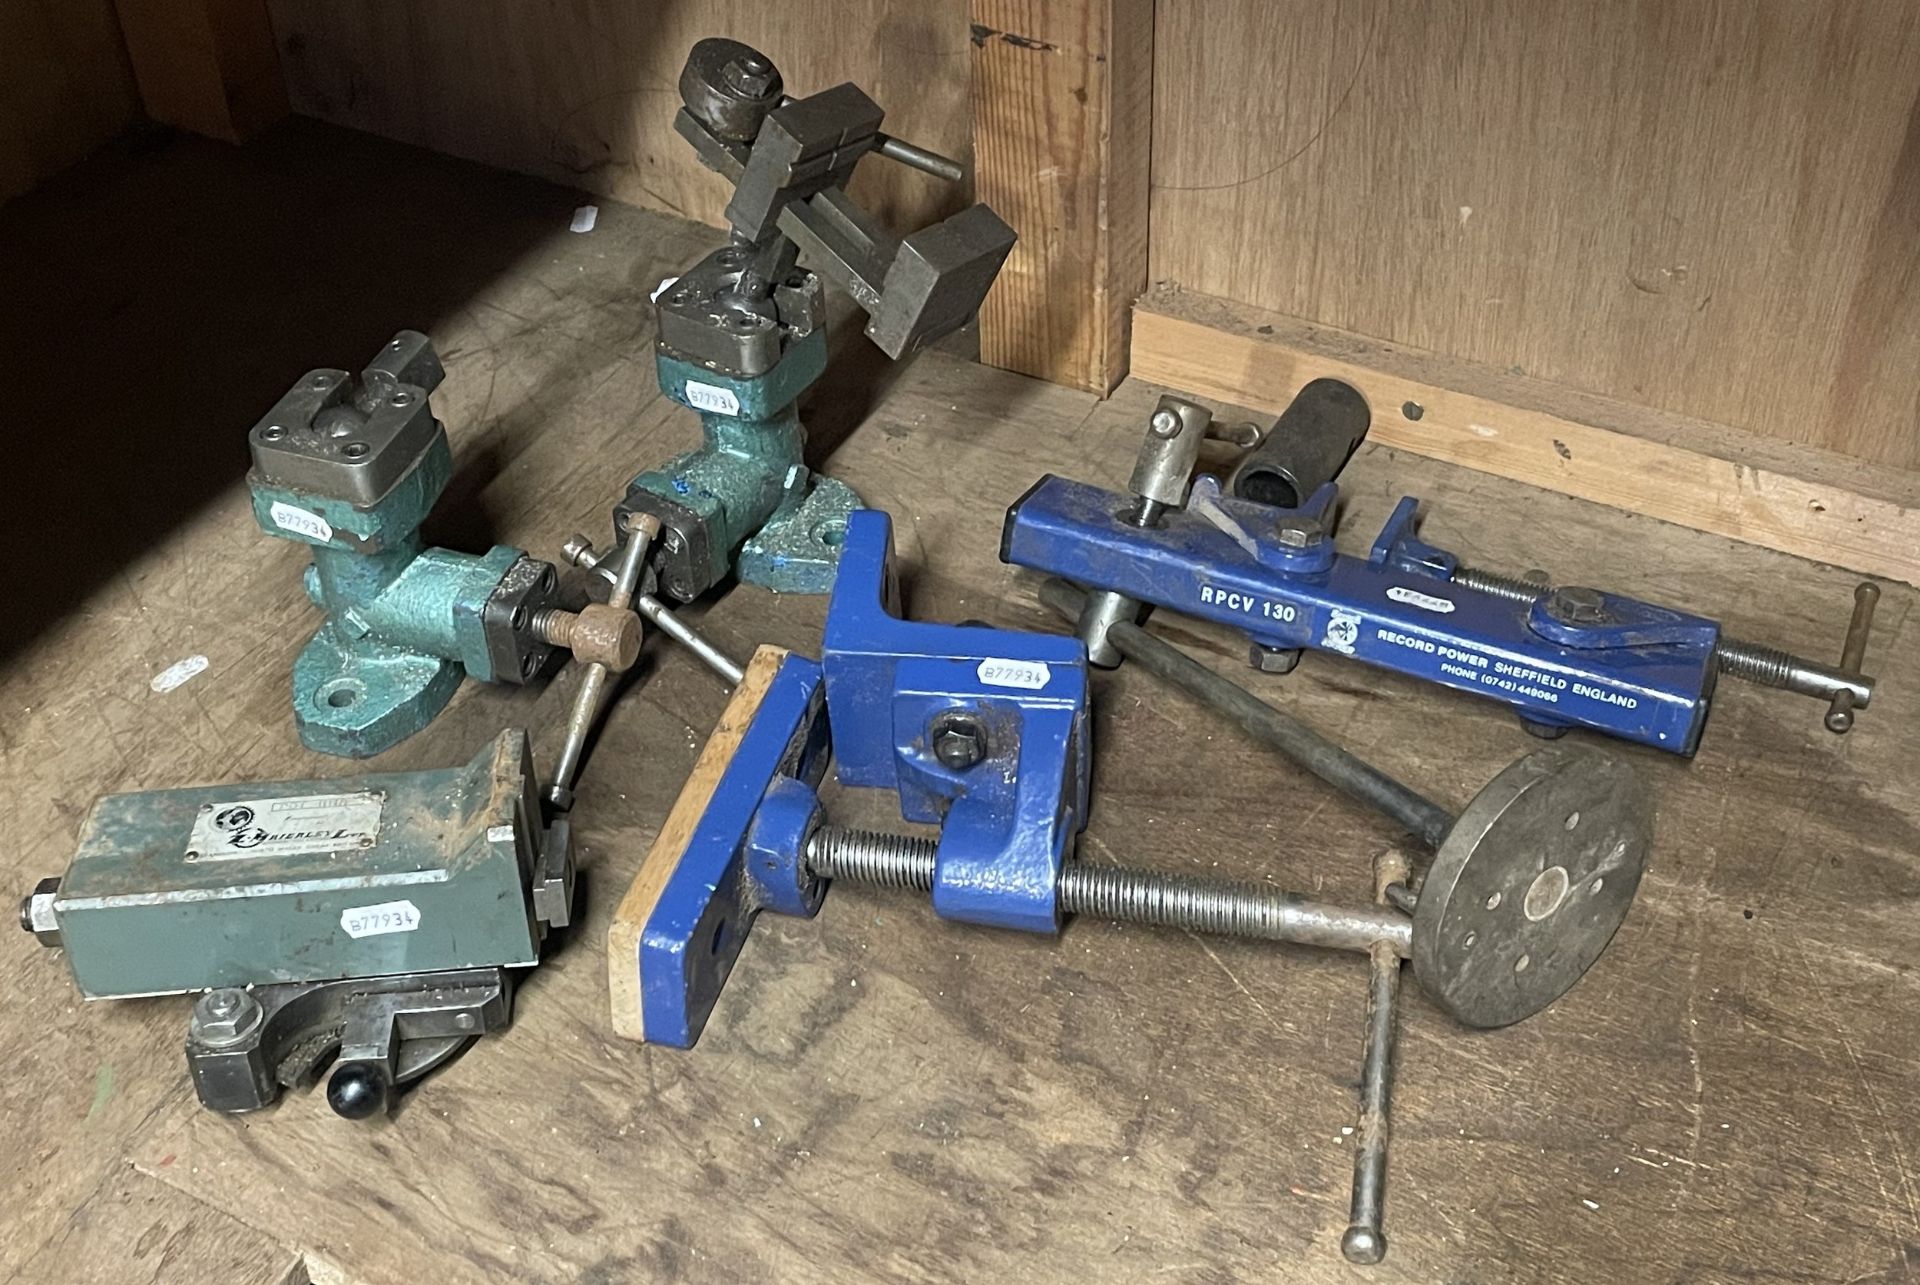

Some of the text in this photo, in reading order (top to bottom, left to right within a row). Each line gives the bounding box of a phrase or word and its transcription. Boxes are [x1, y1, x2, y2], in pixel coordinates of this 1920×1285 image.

[691, 390, 734, 411] B77934
[277, 511, 327, 538] B77934
[1200, 586, 1296, 623] RPCV 130
[984, 666, 1041, 684] B77934
[1377, 629, 1435, 654] RECORD
[1437, 645, 1489, 669] POWER
[1494, 661, 1567, 690] SHEFFIELD
[1572, 683, 1638, 709] ENGLAND
[1441, 663, 1478, 681] PHONE
[350, 911, 413, 932] B77934
